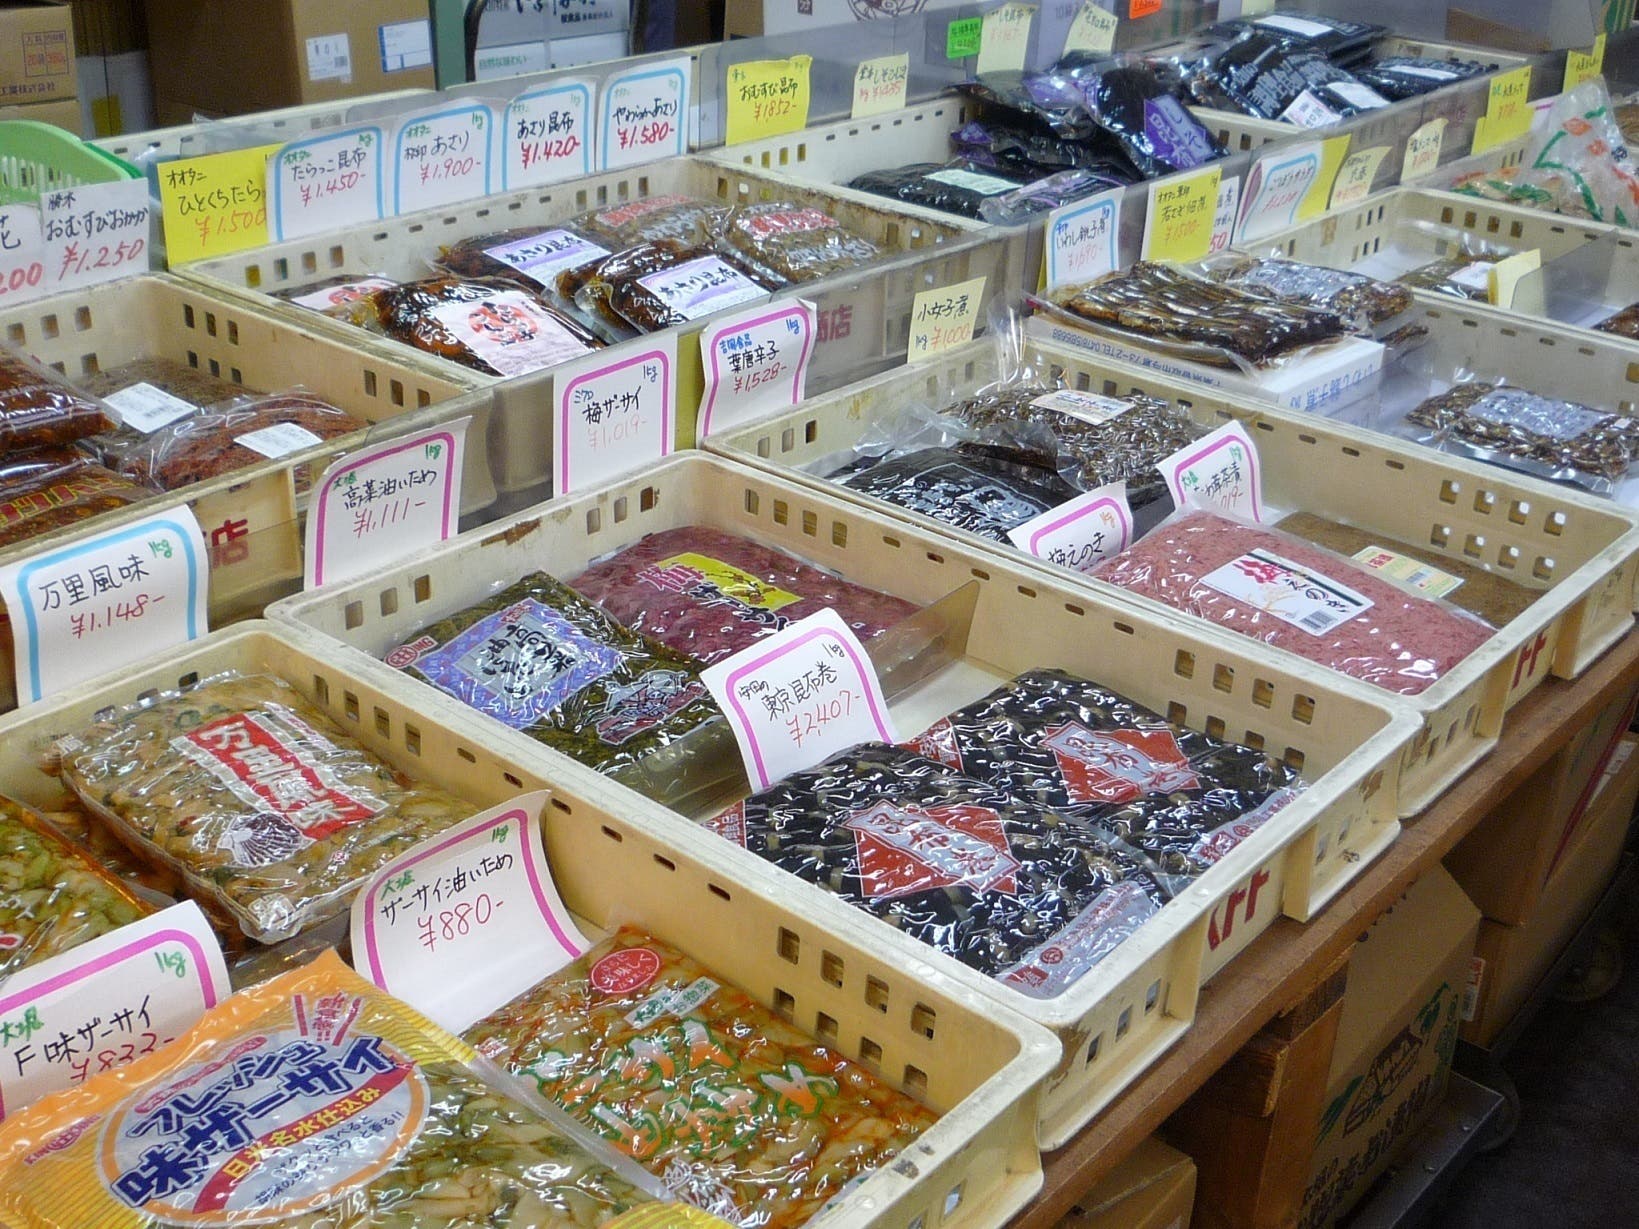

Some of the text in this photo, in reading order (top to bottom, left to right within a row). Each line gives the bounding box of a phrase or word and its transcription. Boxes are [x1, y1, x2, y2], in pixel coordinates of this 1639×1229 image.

[148, 539, 173, 559] 1kg
[39, 554, 150, 611] 万里風味
[761, 660, 838, 722] 東京昆布巻
[380, 853, 513, 926] ザーサイ油いため
[154, 951, 187, 978] 1kg
[126, 1039, 328, 1138] フレッシュ
[111, 1035, 397, 1208] 味ザーサイ
